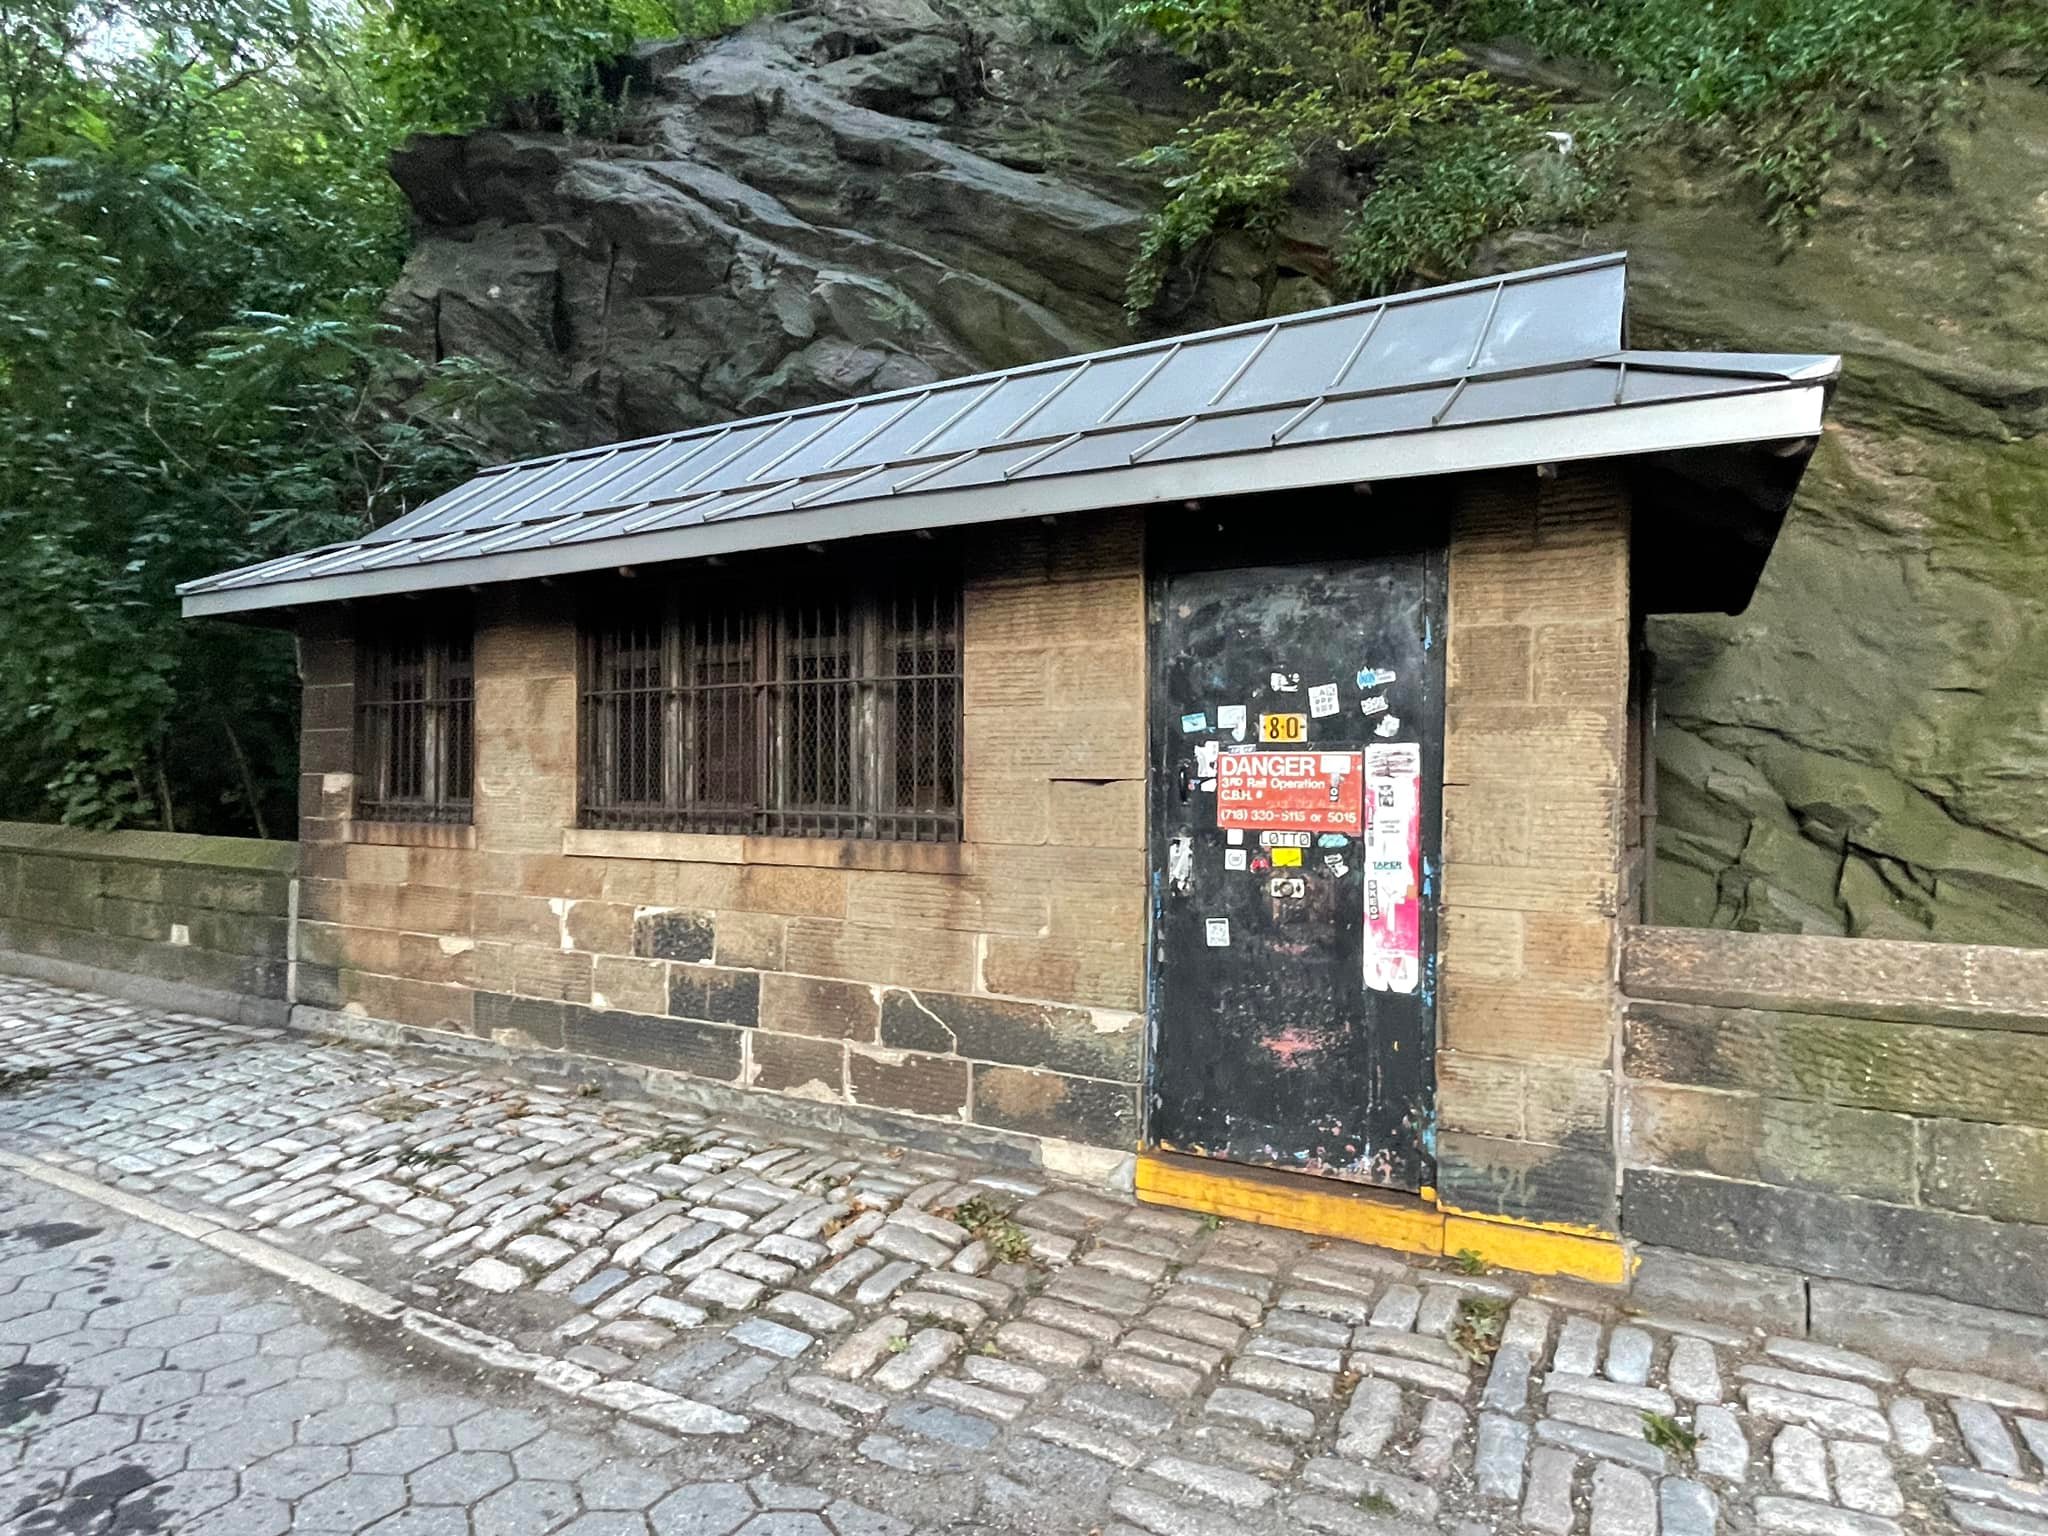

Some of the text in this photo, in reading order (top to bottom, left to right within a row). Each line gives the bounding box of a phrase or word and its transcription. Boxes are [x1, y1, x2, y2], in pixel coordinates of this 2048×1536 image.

[1221, 756, 1316, 777] DANGER
[1221, 777, 1325, 790] 3RD Rail Operation
[1220, 809, 1357, 824] (718) 330-5115 or 5015
